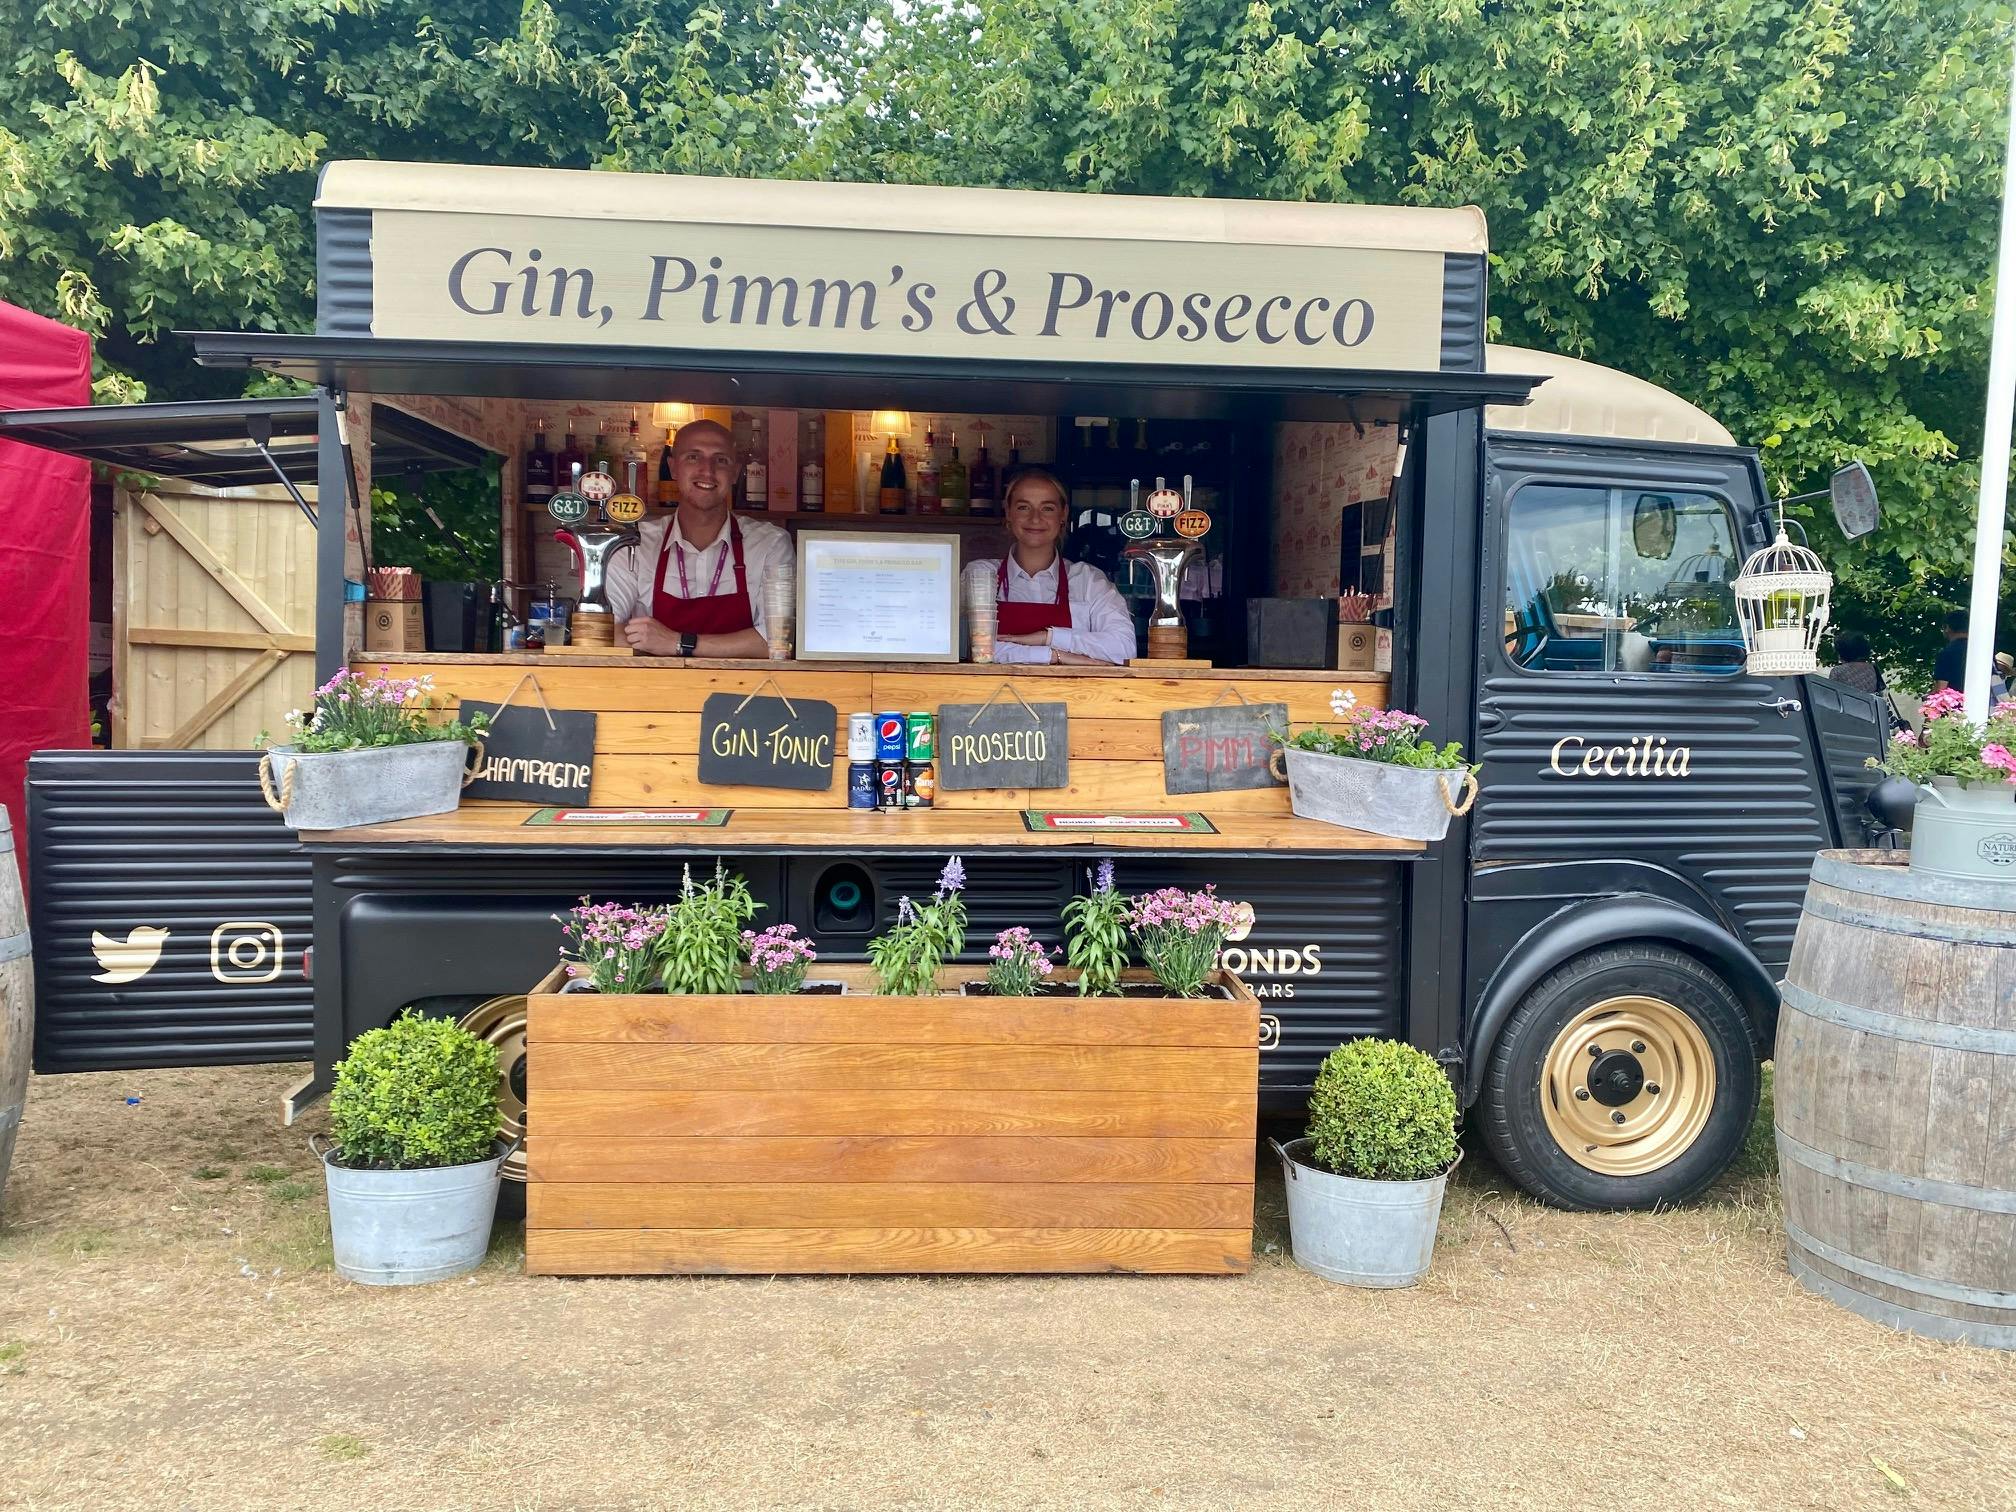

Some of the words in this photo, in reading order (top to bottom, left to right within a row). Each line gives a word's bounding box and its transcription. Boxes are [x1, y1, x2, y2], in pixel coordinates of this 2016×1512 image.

[448, 247, 613, 329] Gin,
[639, 255, 937, 332] Pimm's
[956, 269, 1017, 336] &
[1036, 272, 1375, 347] Prosecco
[554, 499, 582, 514] G&T
[612, 501, 638, 513] FIZZ
[1125, 517, 1151, 531] G&T
[1180, 517, 1205, 529] FIZZ
[712, 722, 758, 757] GIN
[768, 724, 831, 767] TONIC
[882, 744, 901, 752] pepsi
[951, 730, 1046, 766] PROSECCO
[1551, 735, 1691, 777] Cecilia
[1245, 983, 1295, 998] BARS
